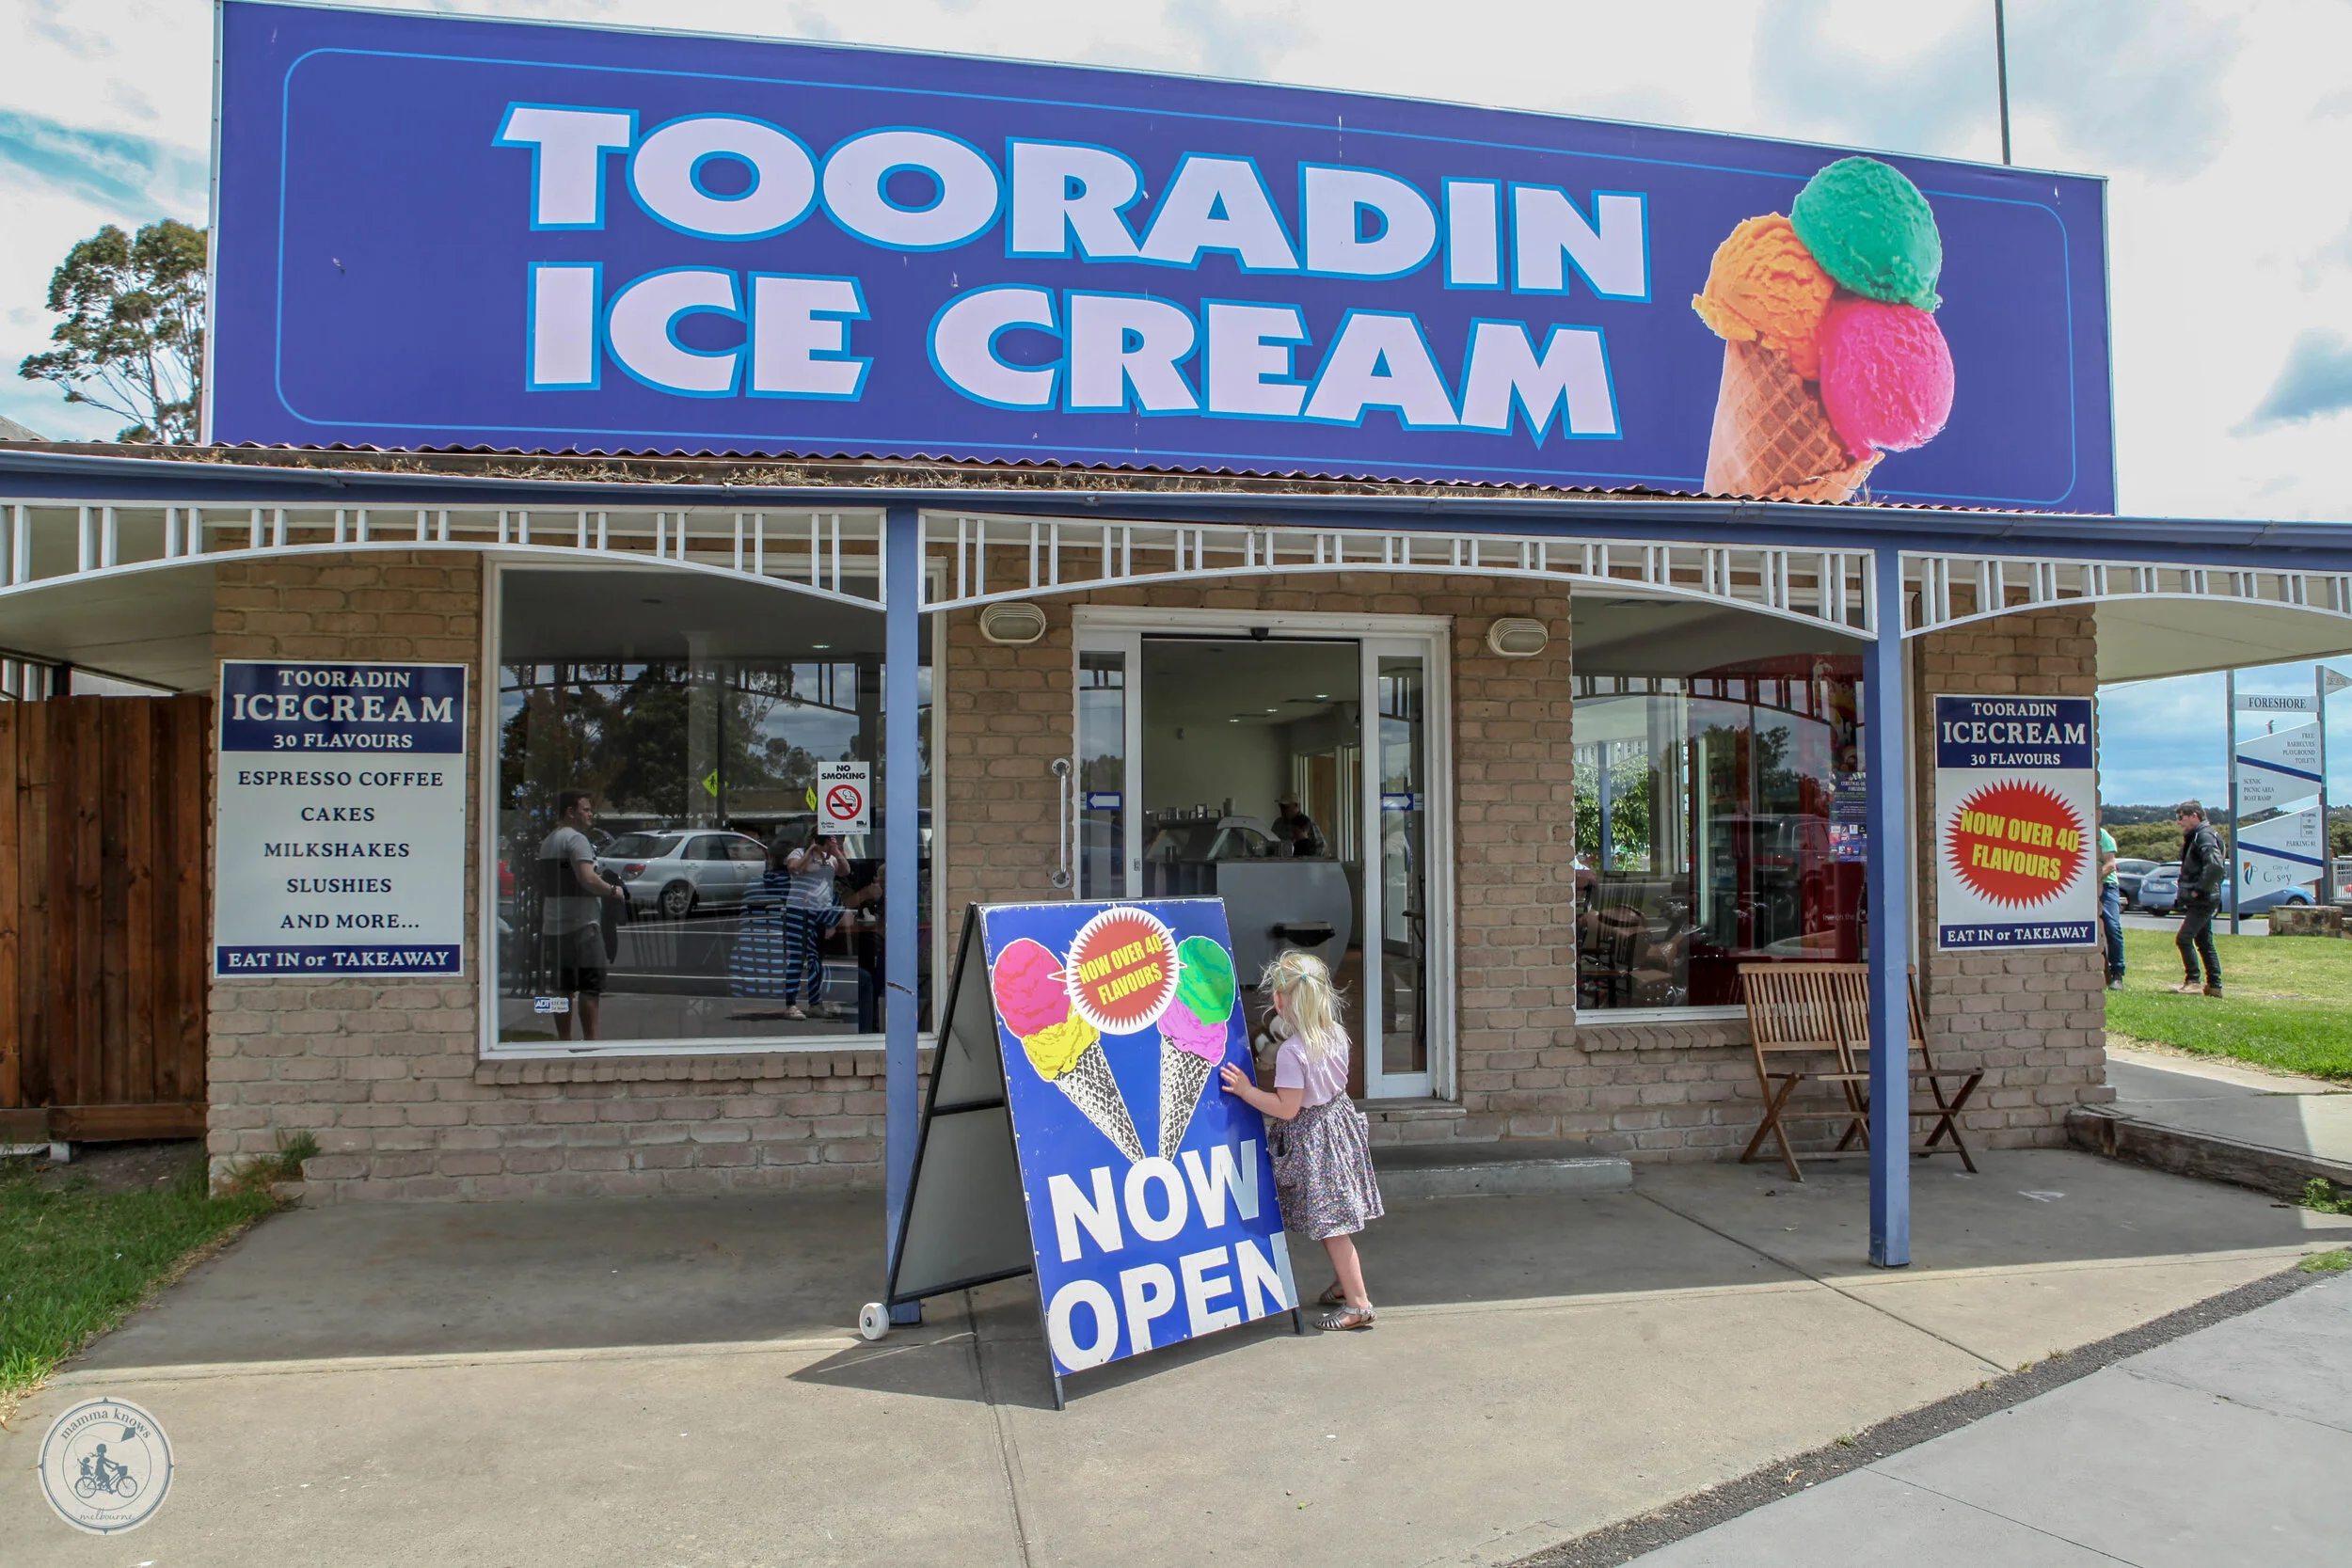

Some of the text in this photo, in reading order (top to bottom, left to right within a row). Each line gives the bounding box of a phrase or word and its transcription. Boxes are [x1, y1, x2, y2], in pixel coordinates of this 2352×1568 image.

[497, 104, 1648, 299] TOORADIN
[530, 264, 1619, 446] ICE CREAM
[278, 670, 410, 688] TOORADIN
[233, 693, 453, 723] ICECREAM
[1971, 702, 2057, 717] TOORADIN
[2249, 697, 2307, 709] FORESHORE
[273, 734, 413, 749] 30 FLAVOURS
[1943, 721, 2086, 745] ICECREAM
[1970, 752, 2060, 767] 30 FLAVOURS
[238, 770, 443, 786] ESPRESSO COFFEE
[300, 807, 375, 822] CAKES
[1960, 809, 2079, 853] NOW OVER 40
[264, 843, 410, 858] MILKSHAKES
[1971, 844, 2061, 881] FLAVOURS
[287, 879, 391, 893] SLUSHIES
[280, 914, 420, 929] AND MORE...
[1947, 927, 2089, 942] EAT IN or TAKEAWAY
[229, 951, 449, 967] EAT IN or TAKEAWAY
[1077, 933, 1163, 985] NOW OVER 40
[1097, 961, 1163, 1006] FLAVOURS
[1047, 1138, 1260, 1262] NOW
[1048, 1231, 1299, 1372] OPEN
